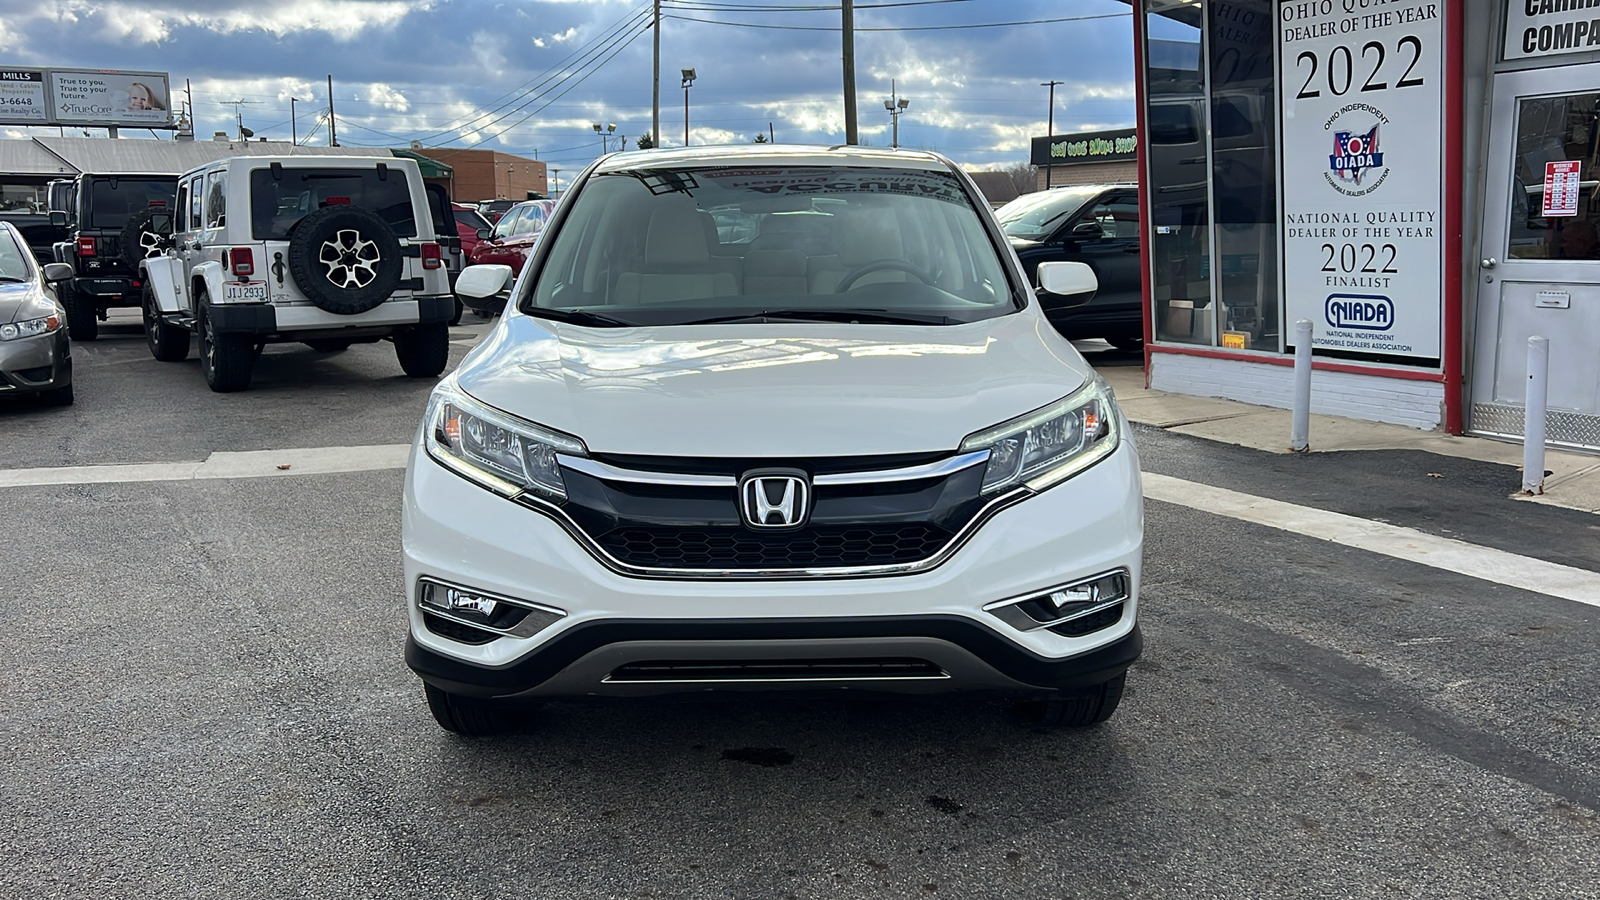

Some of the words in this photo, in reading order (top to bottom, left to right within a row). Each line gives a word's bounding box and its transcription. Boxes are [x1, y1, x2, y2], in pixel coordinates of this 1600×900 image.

[1282, 0, 1332, 22] OHIO
[1342, 0, 1401, 14] QU
[1285, 21, 1337, 42] DEALER
[1340, 17, 1359, 34] OF
[1362, 12, 1392, 29] THE
[1395, 4, 1437, 24] YEAR
[1296, 35, 1424, 99] 2022
[2, 72, 31, 80] MILLS
[11, 107, 30, 116] Realty
[69, 103, 112, 114] TrueCore
[1323, 111, 1340, 131] OHIO
[1340, 103, 1390, 125] INDEPENDENT
[1335, 154, 1375, 169] OIADA
[1346, 189, 1366, 197] DEALERS
[1366, 167, 1390, 194] ASSOCIATION
[1287, 212, 1360, 224] NATIONAL
[1366, 211, 1436, 225] QUALITY
[1289, 228, 1337, 238] DEALER
[1342, 228, 1358, 238] OF
[1364, 228, 1391, 238] THE
[1396, 227, 1434, 238] YEAR
[1320, 243, 1398, 273] 2022
[1326, 276, 1391, 288] FINALIST
[1330, 301, 1388, 323] NIADA
[1326, 330, 1354, 339] NATIONAL
[1355, 332, 1395, 342] INDEPENDENT
[1346, 341, 1371, 349] DEALERS
[1371, 343, 1413, 352] ASSOCIATION
